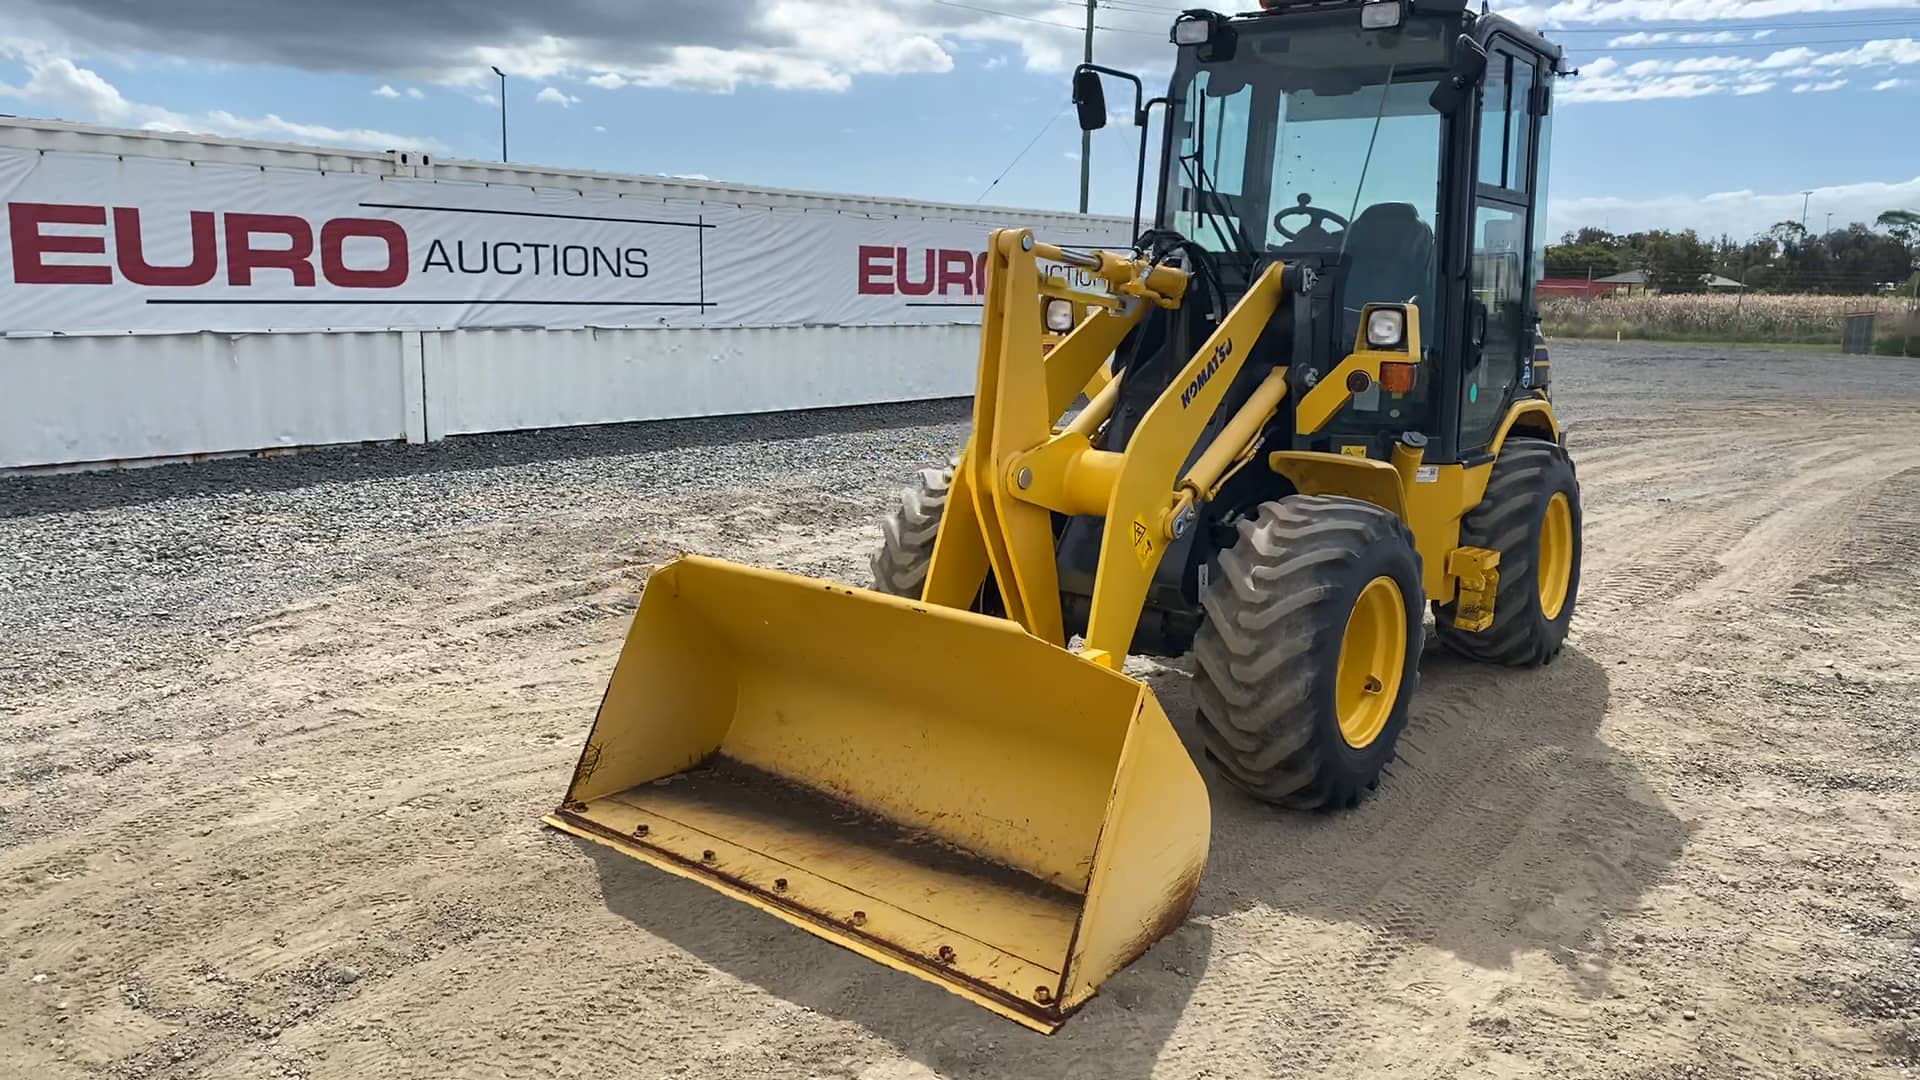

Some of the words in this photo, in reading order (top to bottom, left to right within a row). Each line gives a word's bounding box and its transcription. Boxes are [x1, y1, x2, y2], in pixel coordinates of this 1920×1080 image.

[8, 202, 409, 288] EURO
[422, 239, 649, 278] AUCTIONS
[1180, 337, 1233, 410] KOMATSU
